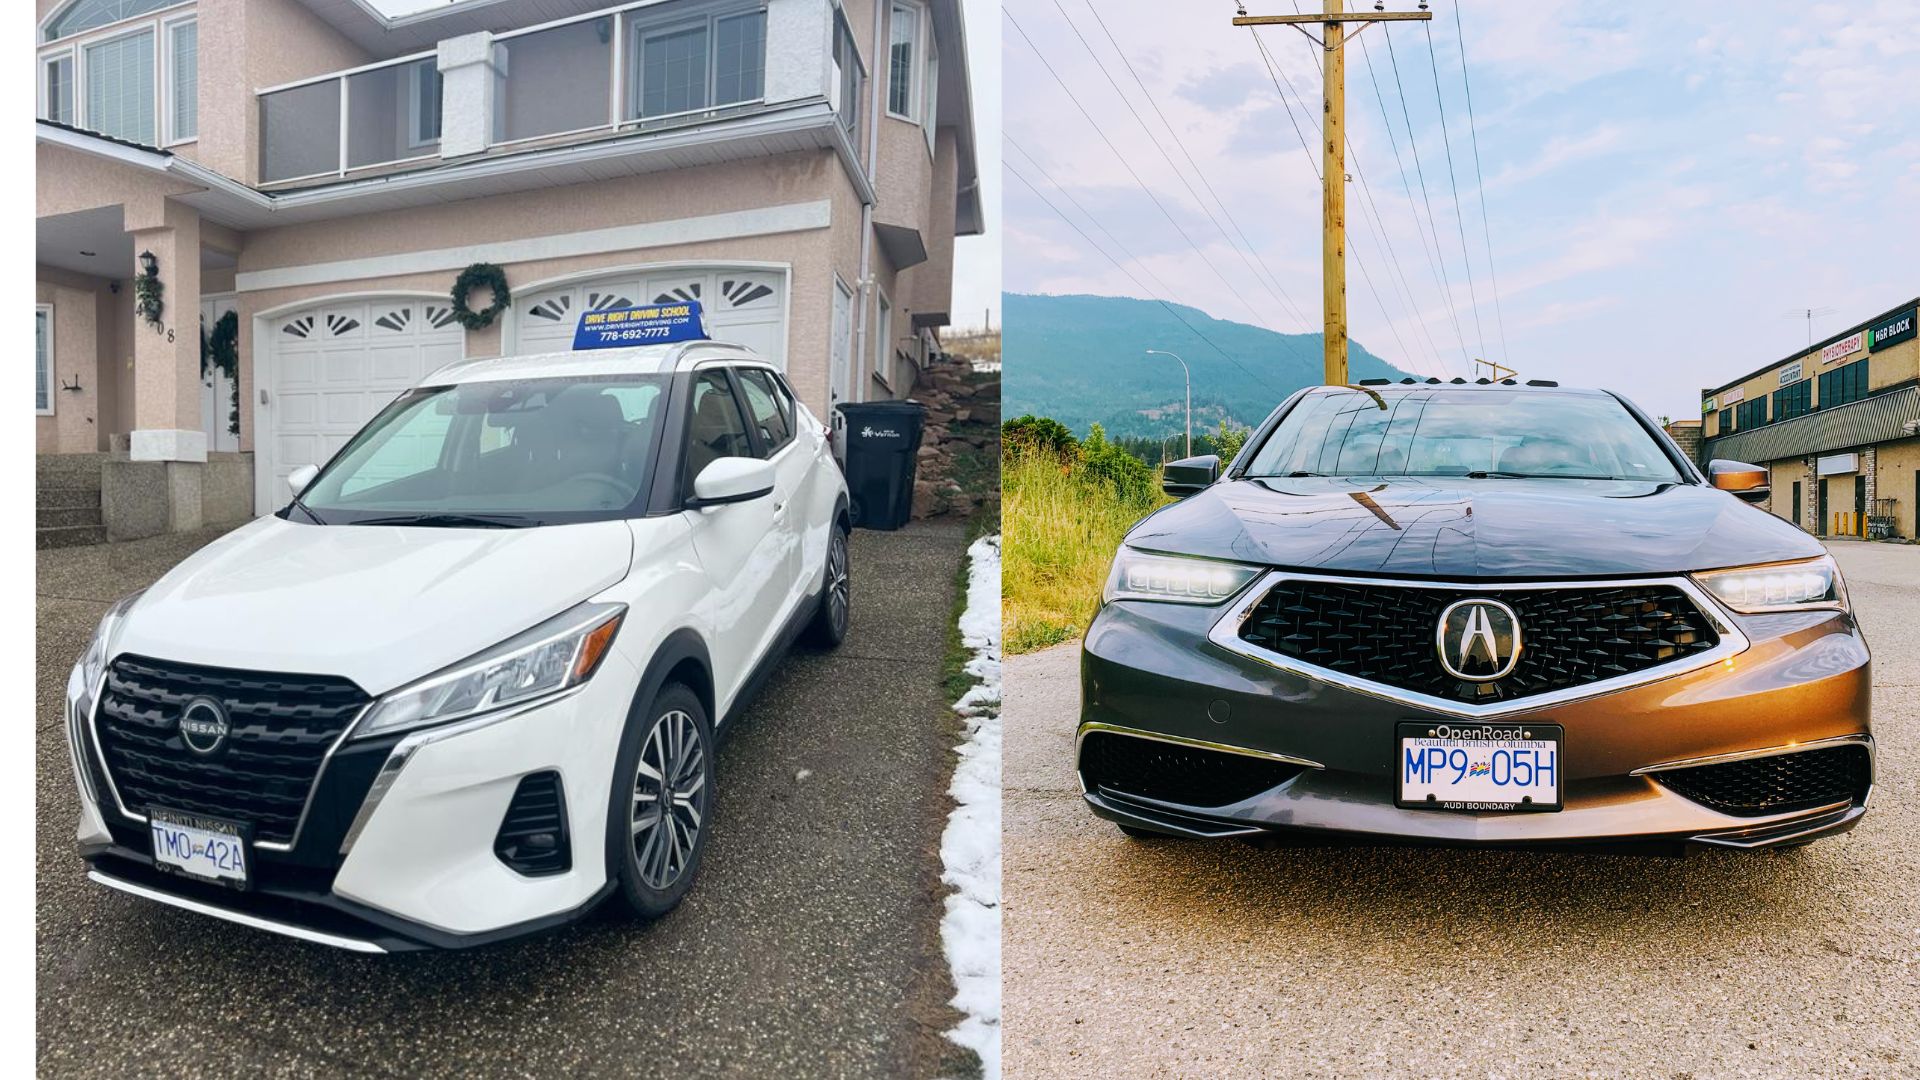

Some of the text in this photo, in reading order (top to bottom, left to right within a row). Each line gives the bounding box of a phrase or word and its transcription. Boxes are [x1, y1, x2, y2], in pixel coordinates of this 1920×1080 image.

[585, 306, 690, 324] DRIVE RIGHT DRIVING SCHOOL
[584, 318, 690, 331] WWW.DRIVERIGHTDRIVING.COM
[1889, 317, 1910, 336] BLOCK
[600, 327, 670, 341] 778-692-7773
[1823, 336, 1860, 360] PHYSIOTHERAPY
[179, 720, 228, 735] NISSAN
[1436, 725, 1523, 741] OpenRoad
[1443, 801, 1515, 811] AUDI BOUNDARY
